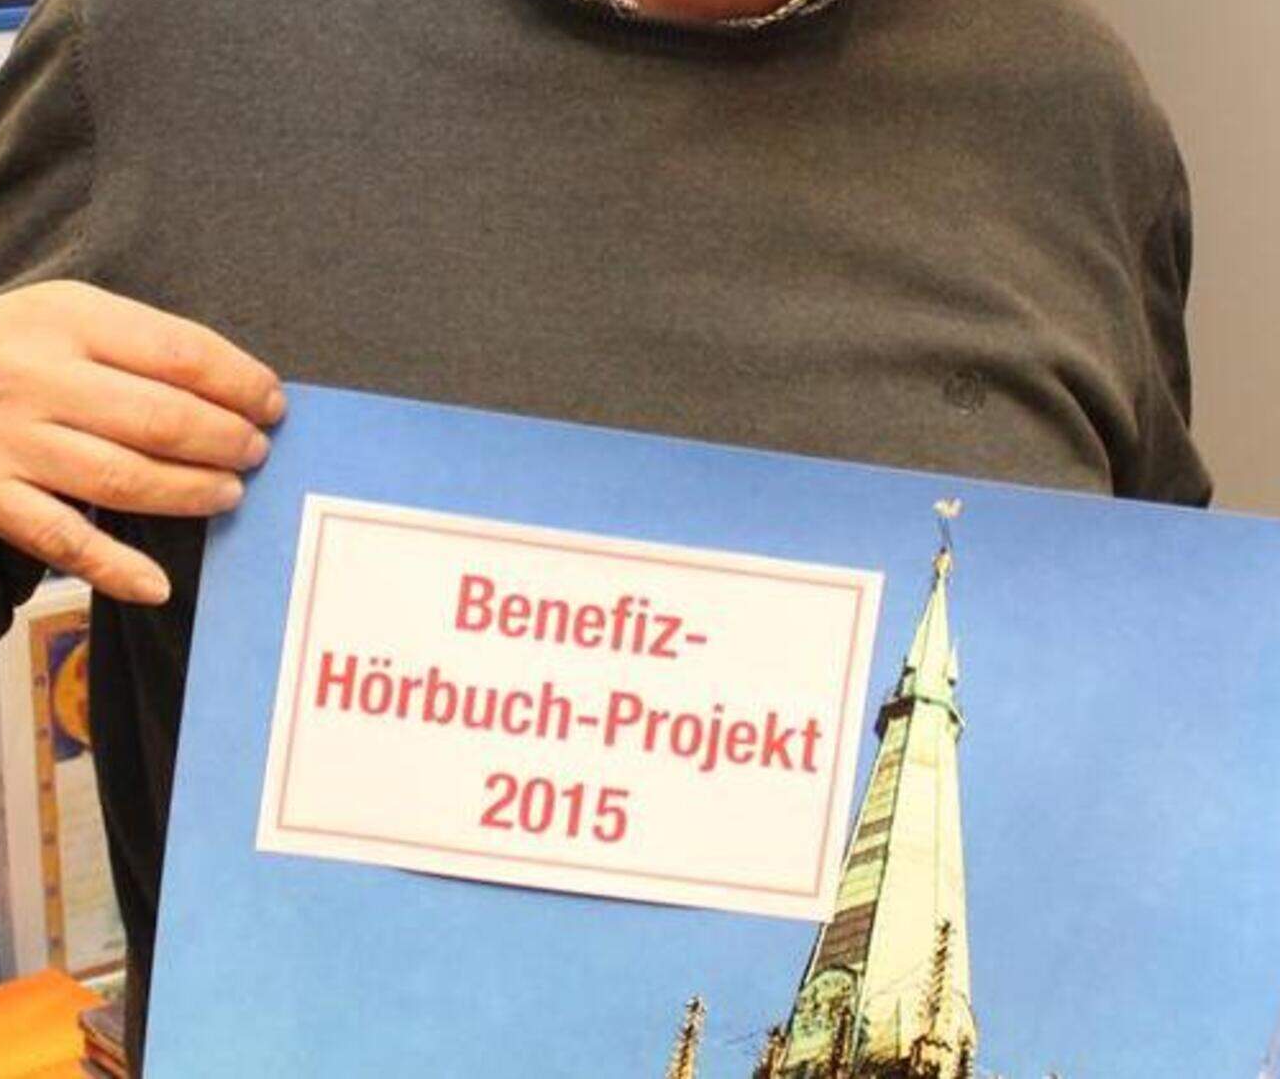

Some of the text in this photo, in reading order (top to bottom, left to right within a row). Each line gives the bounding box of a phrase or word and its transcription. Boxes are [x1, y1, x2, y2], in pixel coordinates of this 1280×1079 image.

[453, 573, 709, 661] Benefiz-
[313, 650, 823, 774] Hörbuch-Projekt
[479, 772, 631, 844] 2015
